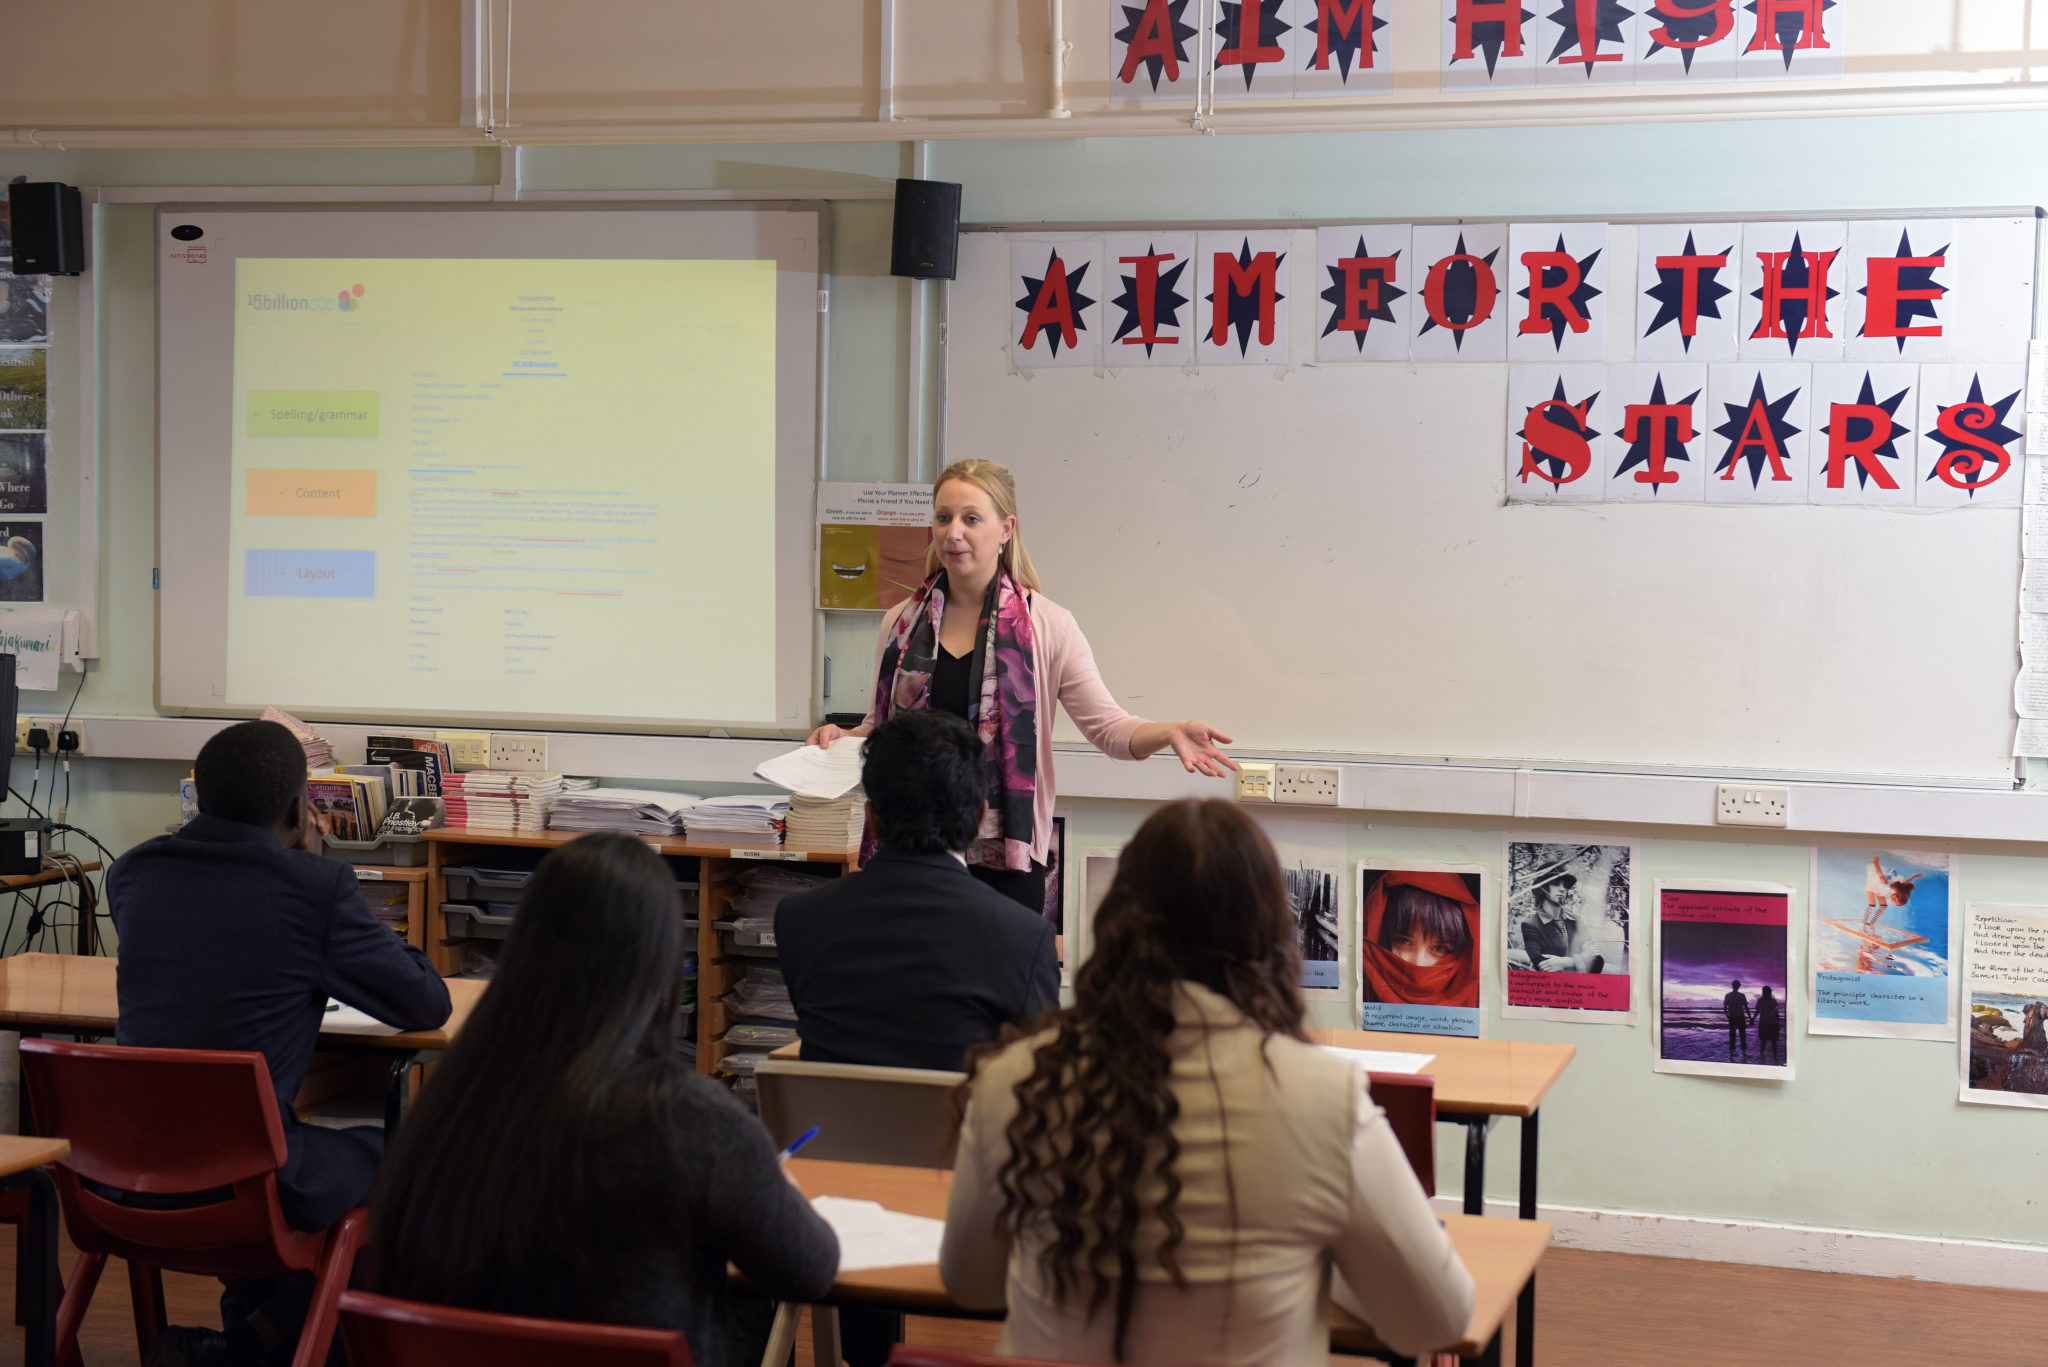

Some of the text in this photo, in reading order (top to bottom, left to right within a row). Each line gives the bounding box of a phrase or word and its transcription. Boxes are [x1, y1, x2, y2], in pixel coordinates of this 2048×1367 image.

[1022, 251, 1945, 349] AIM FOR THE
[270, 408, 368, 422] Spelling/grammar
[1522, 399, 2011, 489] STARS
[296, 488, 341, 499] Content
[298, 568, 336, 581] Layout
[382, 817, 420, 827] Priestley
[1817, 973, 1861, 983] Protagonist
[2002, 974, 2028, 983] Taylor
[1833, 992, 1866, 1000] principle
[1817, 998, 1846, 1007] literary
